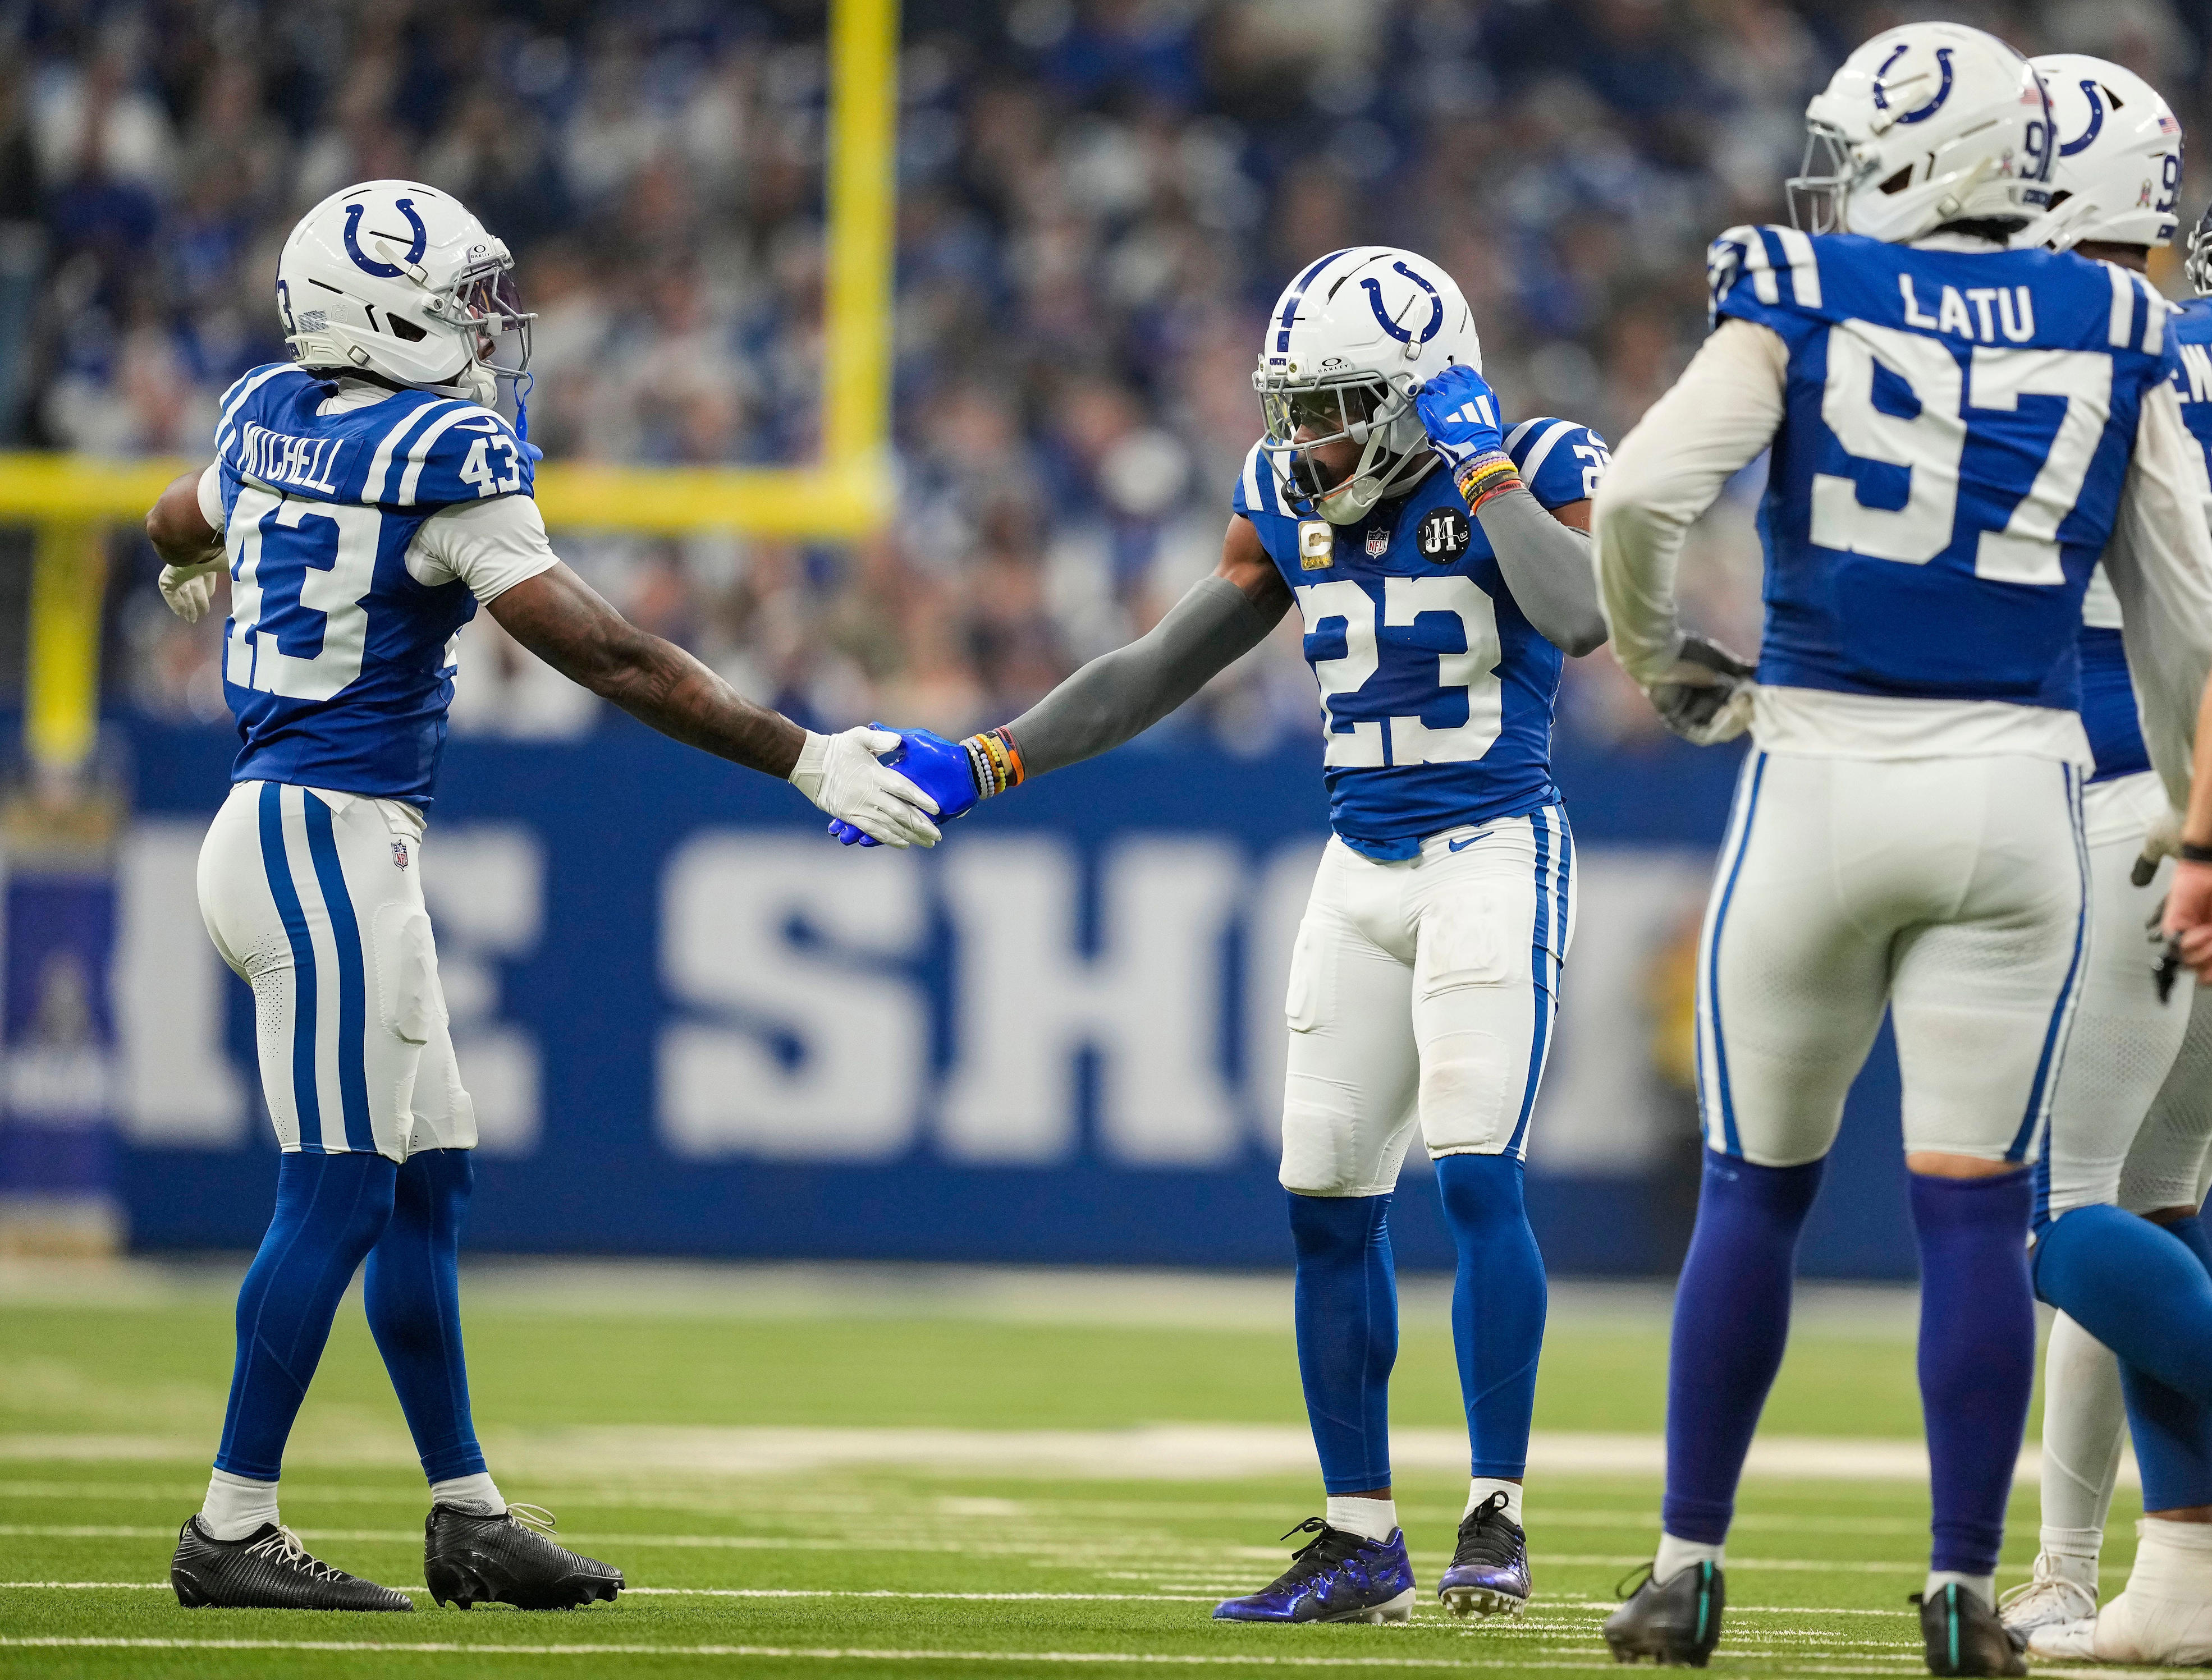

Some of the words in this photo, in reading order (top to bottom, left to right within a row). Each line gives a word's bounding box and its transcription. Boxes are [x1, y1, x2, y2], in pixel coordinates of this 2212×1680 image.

[2020, 121, 2058, 182] 9
[1899, 274, 2036, 343] LATU
[1318, 365, 1349, 373] OAKLEY
[236, 421, 344, 494] MITCHELL
[459, 434, 522, 498] 43
[1810, 318, 2113, 585] 97
[1300, 522, 1332, 557] C
[1369, 540, 1384, 552] NFL
[226, 485, 383, 703] 43
[1294, 575, 1503, 768] 23
